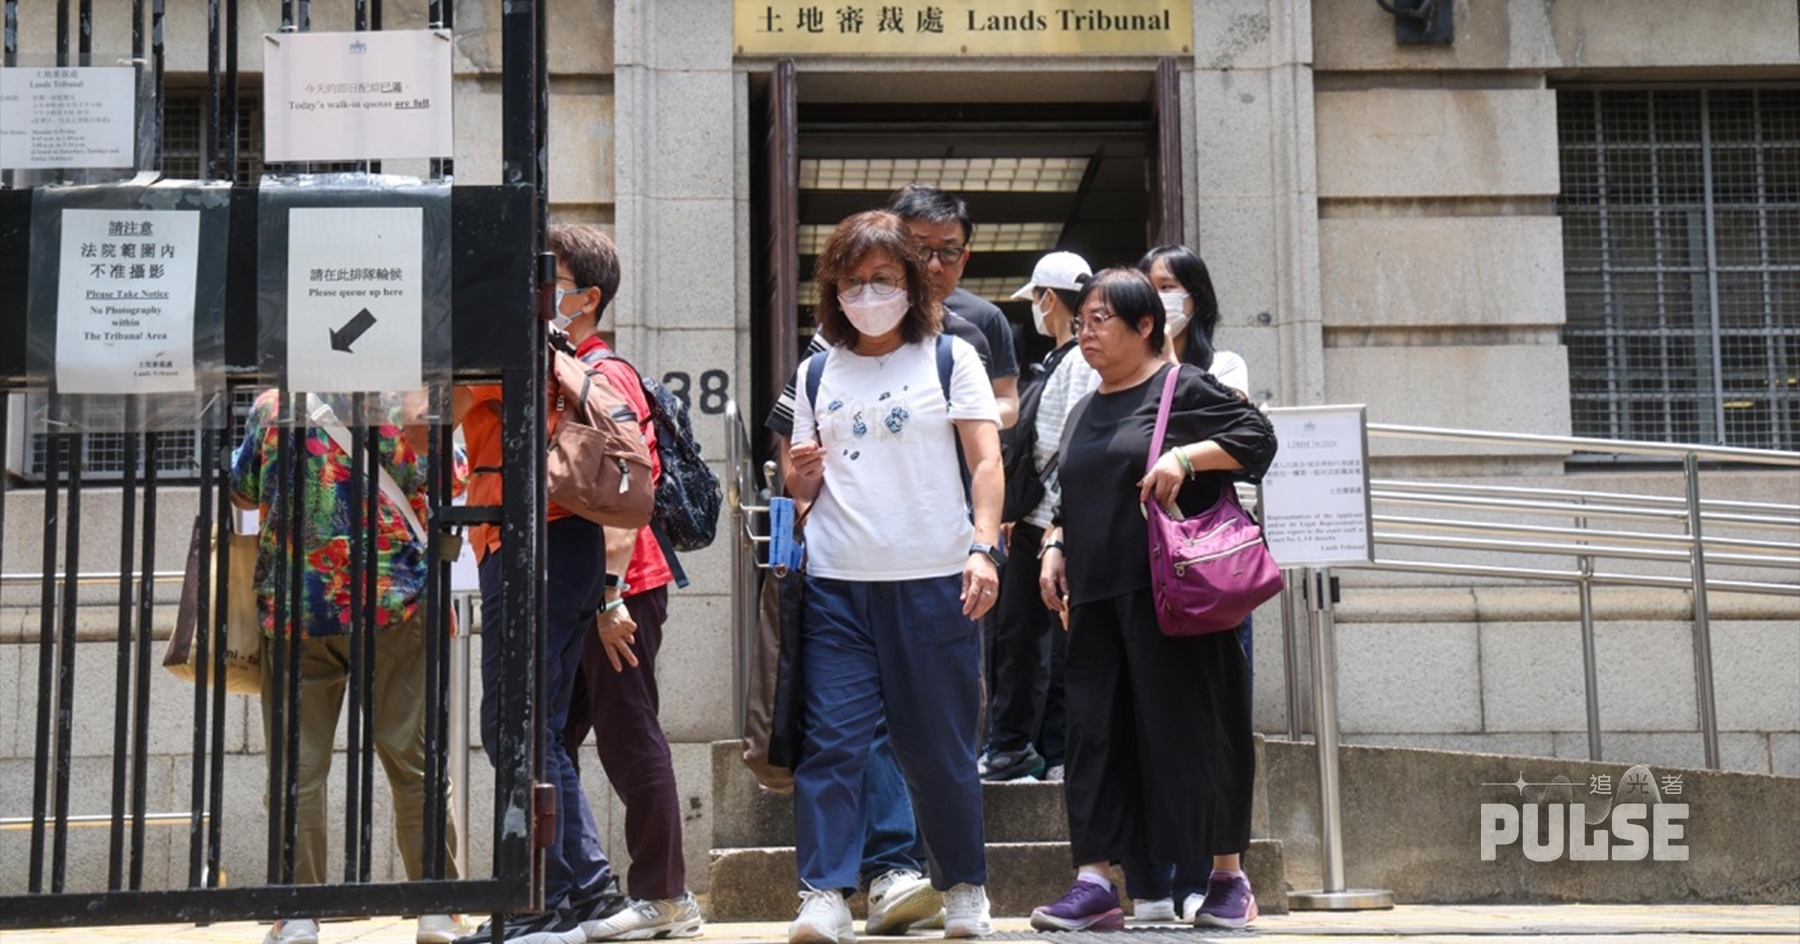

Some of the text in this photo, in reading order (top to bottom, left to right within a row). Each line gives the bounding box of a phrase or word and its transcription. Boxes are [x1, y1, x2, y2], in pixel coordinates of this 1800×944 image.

[756, 5, 1171, 34] 土地審裁處 Lands Tribunal
[288, 101, 325, 111] Today's
[327, 100, 361, 109] walk-in
[363, 100, 393, 110] quotas
[394, 100, 411, 109] are
[108, 220, 154, 236] 請注意
[80, 242, 175, 259] 法院範圍內
[89, 263, 165, 280] 不准攝影
[85, 290, 170, 299] Please Take Notice
[308, 288, 403, 299] Please queue up here
[89, 305, 162, 316] No Photography
[111, 319, 140, 327] within
[84, 331, 168, 341] The Tribunal Area
